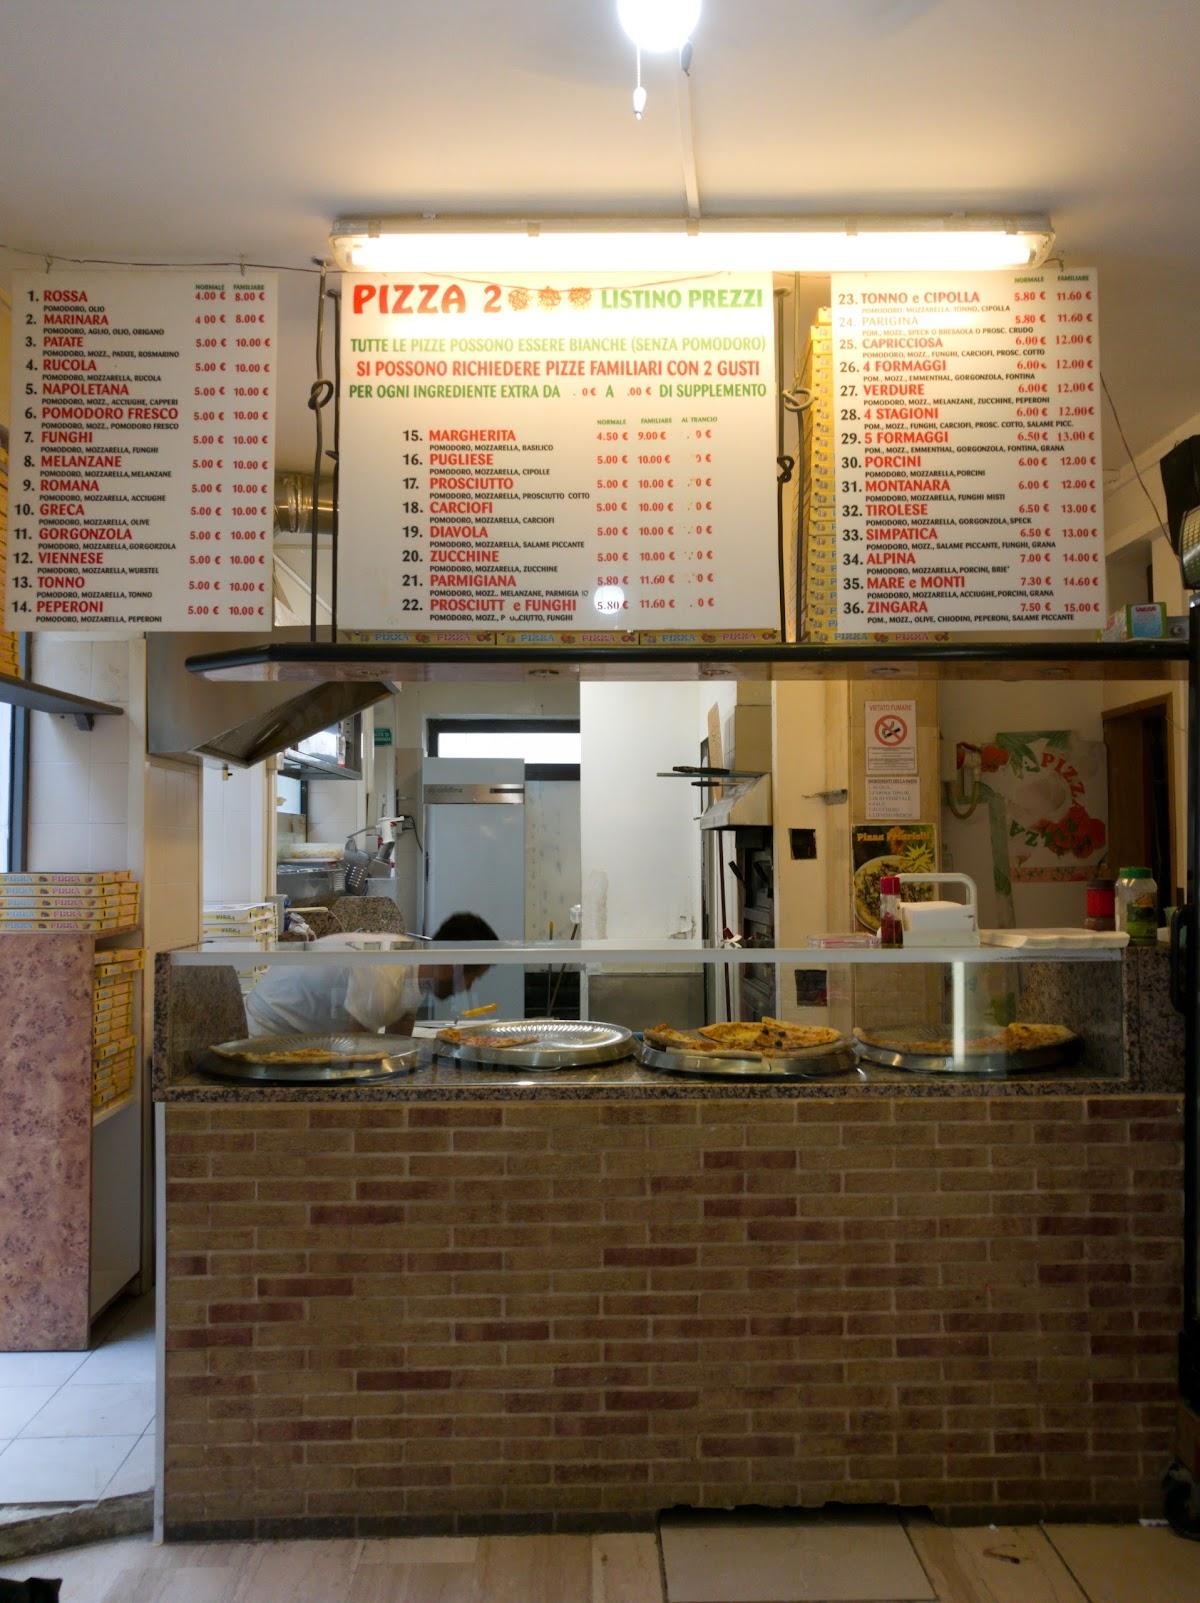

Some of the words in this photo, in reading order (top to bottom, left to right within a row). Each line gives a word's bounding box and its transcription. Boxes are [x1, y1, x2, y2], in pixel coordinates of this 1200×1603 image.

[27, 290, 39, 302] 1.
[43, 290, 88, 302] ROSSA
[353, 284, 466, 314] PIZZA
[484, 284, 502, 313] 2
[599, 287, 682, 309] LISTINO
[688, 288, 763, 308] PREZZI
[838, 293, 858, 305] 23.
[861, 292, 908, 305] TONNO
[912, 294, 919, 304] e
[923, 291, 980, 304] CIPOLLA
[26, 313, 37, 325] 2.
[44, 314, 109, 325] MARINARA
[839, 316, 857, 329] 24.
[862, 316, 918, 326] PARIGINA
[43, 327, 86, 335] POMODORO,
[88, 328, 111, 336] AGLIO,
[112, 328, 131, 336] OLIO,
[25, 336, 36, 347] 3.
[43, 336, 83, 347] PATATE
[350, 338, 389, 353] TUTTE
[392, 337, 408, 352] LE
[411, 337, 447, 352] PIZZE
[449, 337, 516, 352] POSSONO
[518, 337, 565, 352] ESSERE
[568, 337, 627, 352] BIANCHE
[631, 337, 678, 352] (SENZA
[681, 337, 766, 352] POMODORO)
[840, 338, 857, 350] 25.
[862, 337, 943, 349] CAPRICCIOSA
[25, 359, 38, 371] 4.
[43, 359, 97, 371] RUCOLA
[195, 362, 216, 372] 5.00
[235, 363, 260, 373] 10.00
[357, 360, 370, 377] SI
[375, 360, 448, 377] POSSONO
[452, 360, 541, 377] RICHIEDERE
[545, 360, 585, 376] PIZZE
[590, 360, 662, 376] FAMILIARI
[666, 360, 699, 376] CON
[704, 360, 712, 376] 2
[717, 360, 760, 376] GUSTI
[840, 361, 859, 373] 26.
[863, 361, 870, 372] 4
[875, 359, 946, 372] FORMAGGI
[25, 383, 37, 395] 5.
[42, 383, 129, 395] NAPOLETANA
[349, 384, 373, 398] PER
[376, 384, 409, 399] OGNI
[413, 384, 496, 398] INGREDIENTE
[500, 384, 539, 398] EXTRA
[543, 384, 560, 398] DA
[605, 384, 614, 398] A
[659, 384, 673, 398] DI
[676, 383, 767, 397] SUPPLEMENTO
[840, 385, 858, 397] 27.
[863, 384, 924, 396] VERDURE
[25, 407, 37, 419] 6.
[42, 407, 124, 419] POMODORO
[128, 407, 178, 420] FRESCO
[841, 408, 860, 421] 28.
[864, 408, 871, 420] 4
[876, 407, 939, 420] STAGIONI
[24, 431, 34, 443] 7.
[41, 431, 93, 443] FUNGHI
[403, 430, 423, 442] 15.
[429, 429, 516, 442] MARGHERITA
[597, 432, 618, 441] 4.50
[638, 431, 658, 440] 9.00
[841, 432, 861, 445] 29.
[865, 432, 872, 444] 5
[877, 431, 948, 444] FORMAGGI
[429, 444, 473, 452] POMODORO,
[24, 455, 35, 468] 8.
[41, 455, 122, 468] MELANZANE
[403, 453, 423, 466] 16.
[430, 453, 493, 466] PUGLIESE
[841, 456, 862, 469] 30.
[865, 455, 921, 468] PORCINI
[40, 470, 83, 478] POMODORO,
[84, 470, 130, 478] MOZZARELLA,
[23, 479, 35, 492] 9.
[40, 479, 100, 491] ROMANA
[403, 477, 419, 490] 17.
[430, 477, 514, 490] PROSCIUTTO
[842, 480, 862, 493] 31.
[865, 479, 951, 492] MONTANARA
[14, 503, 34, 516] 10.
[39, 503, 85, 516] GRECA
[403, 501, 423, 514] 18.
[429, 501, 493, 514] CARCIOFI
[842, 504, 863, 517] 32.
[865, 503, 928, 516] TIROLESE
[1019, 504, 1040, 513] 6.50
[1061, 504, 1088, 513] 13.00
[866, 519, 909, 527] POMODORO,
[911, 518, 957, 526] MOZZARELLA,
[14, 528, 32, 540] 11.
[39, 528, 132, 540] GORGONZOLA
[402, 525, 423, 538] 19.
[430, 526, 488, 538] DIAVOLA
[842, 529, 863, 541] 33.
[866, 527, 938, 541] SIMPATICA
[13, 552, 33, 564] 12.
[38, 552, 103, 564] VIENNESE
[402, 550, 423, 563] 20.
[430, 550, 499, 563] ZUCCHINE
[843, 553, 863, 566] 34.
[866, 552, 916, 565] ALPINA
[12, 576, 32, 589] 13.
[37, 576, 85, 588] TONNO
[402, 574, 423, 587] 21.
[430, 574, 517, 587] PARMIGIANA
[843, 577, 864, 590] 35.
[867, 576, 905, 589] MARE
[909, 579, 917, 589] e
[920, 575, 965, 588] MONTI
[12, 600, 32, 613] 14.
[37, 601, 103, 613] PEPERONI
[402, 598, 423, 611] 22.
[513, 602, 521, 612] e
[525, 599, 576, 612] FUNGHI
[843, 601, 864, 614] 36.
[867, 600, 928, 614] ZINGARA
[869, 703, 890, 712] VIETATO
